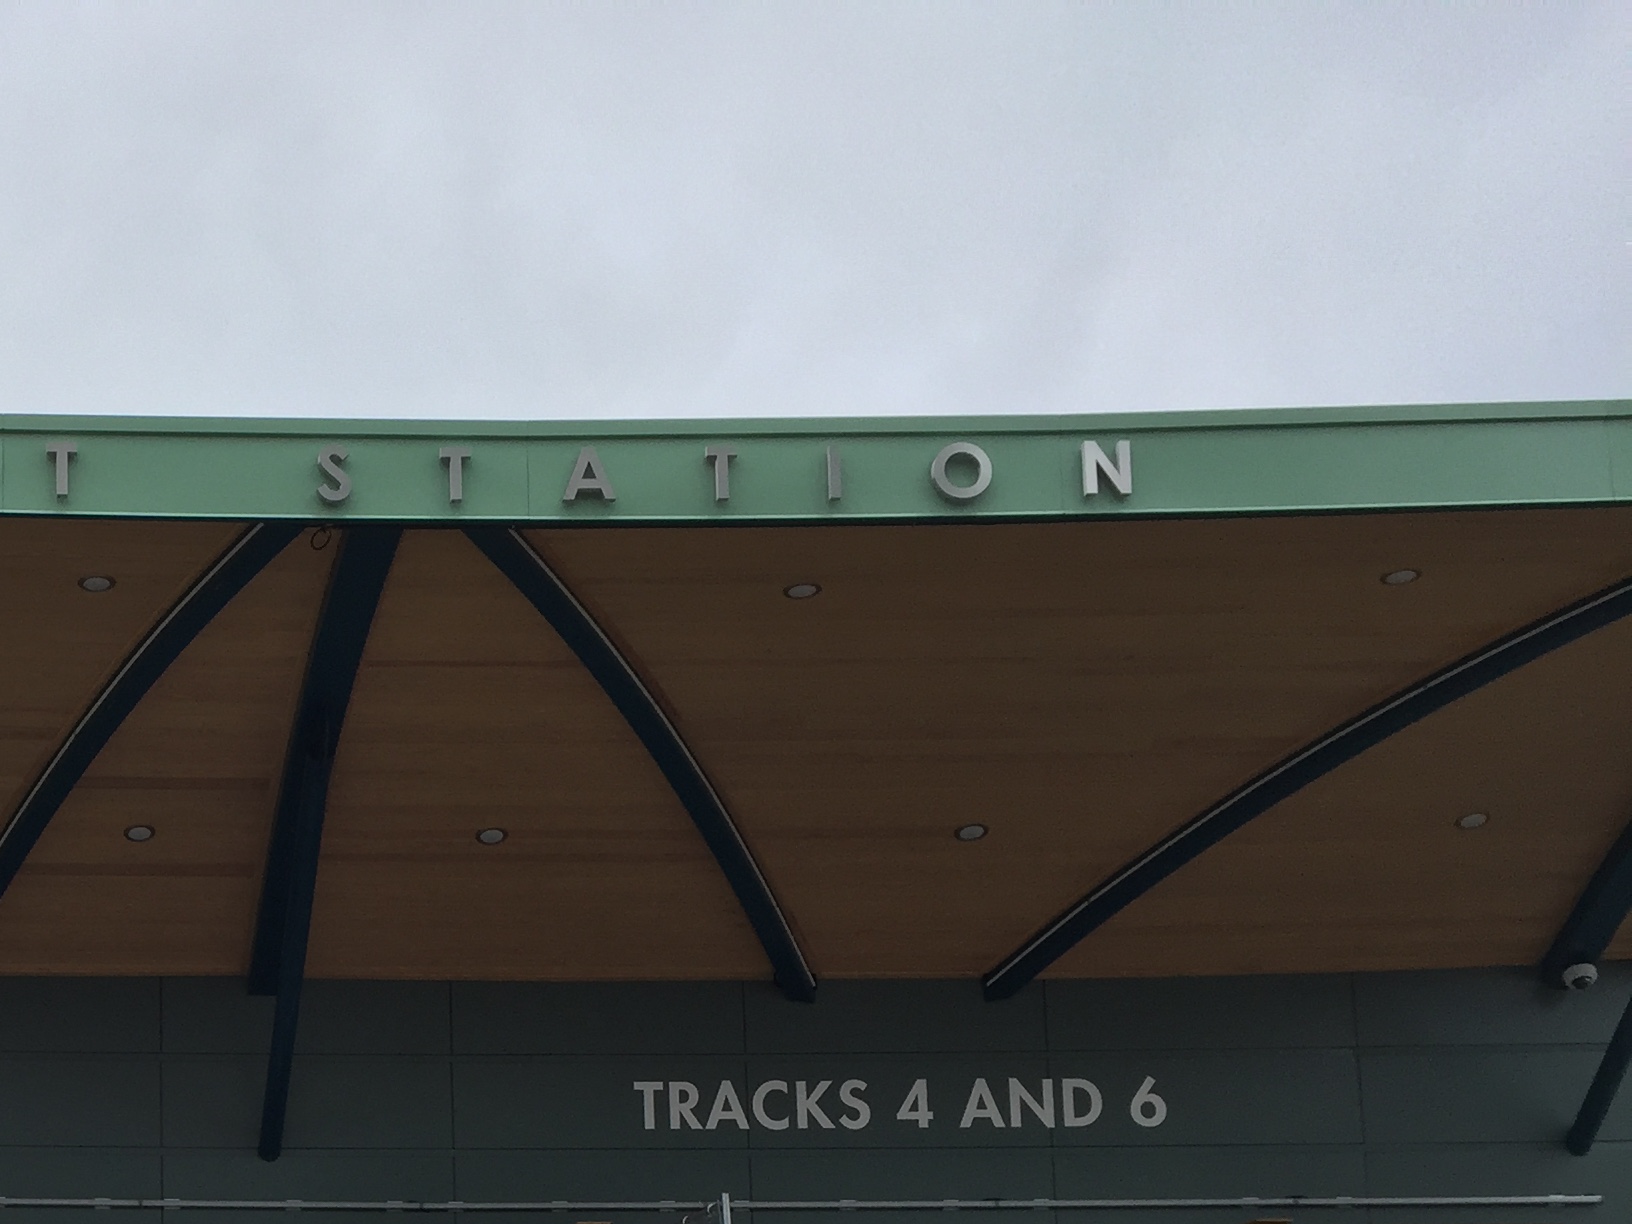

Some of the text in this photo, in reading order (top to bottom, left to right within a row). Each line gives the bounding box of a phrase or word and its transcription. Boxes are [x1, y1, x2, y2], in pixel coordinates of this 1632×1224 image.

[316, 440, 1134, 503] STATION
[633, 1076, 1168, 1131] TRACKS 4 AND 6
